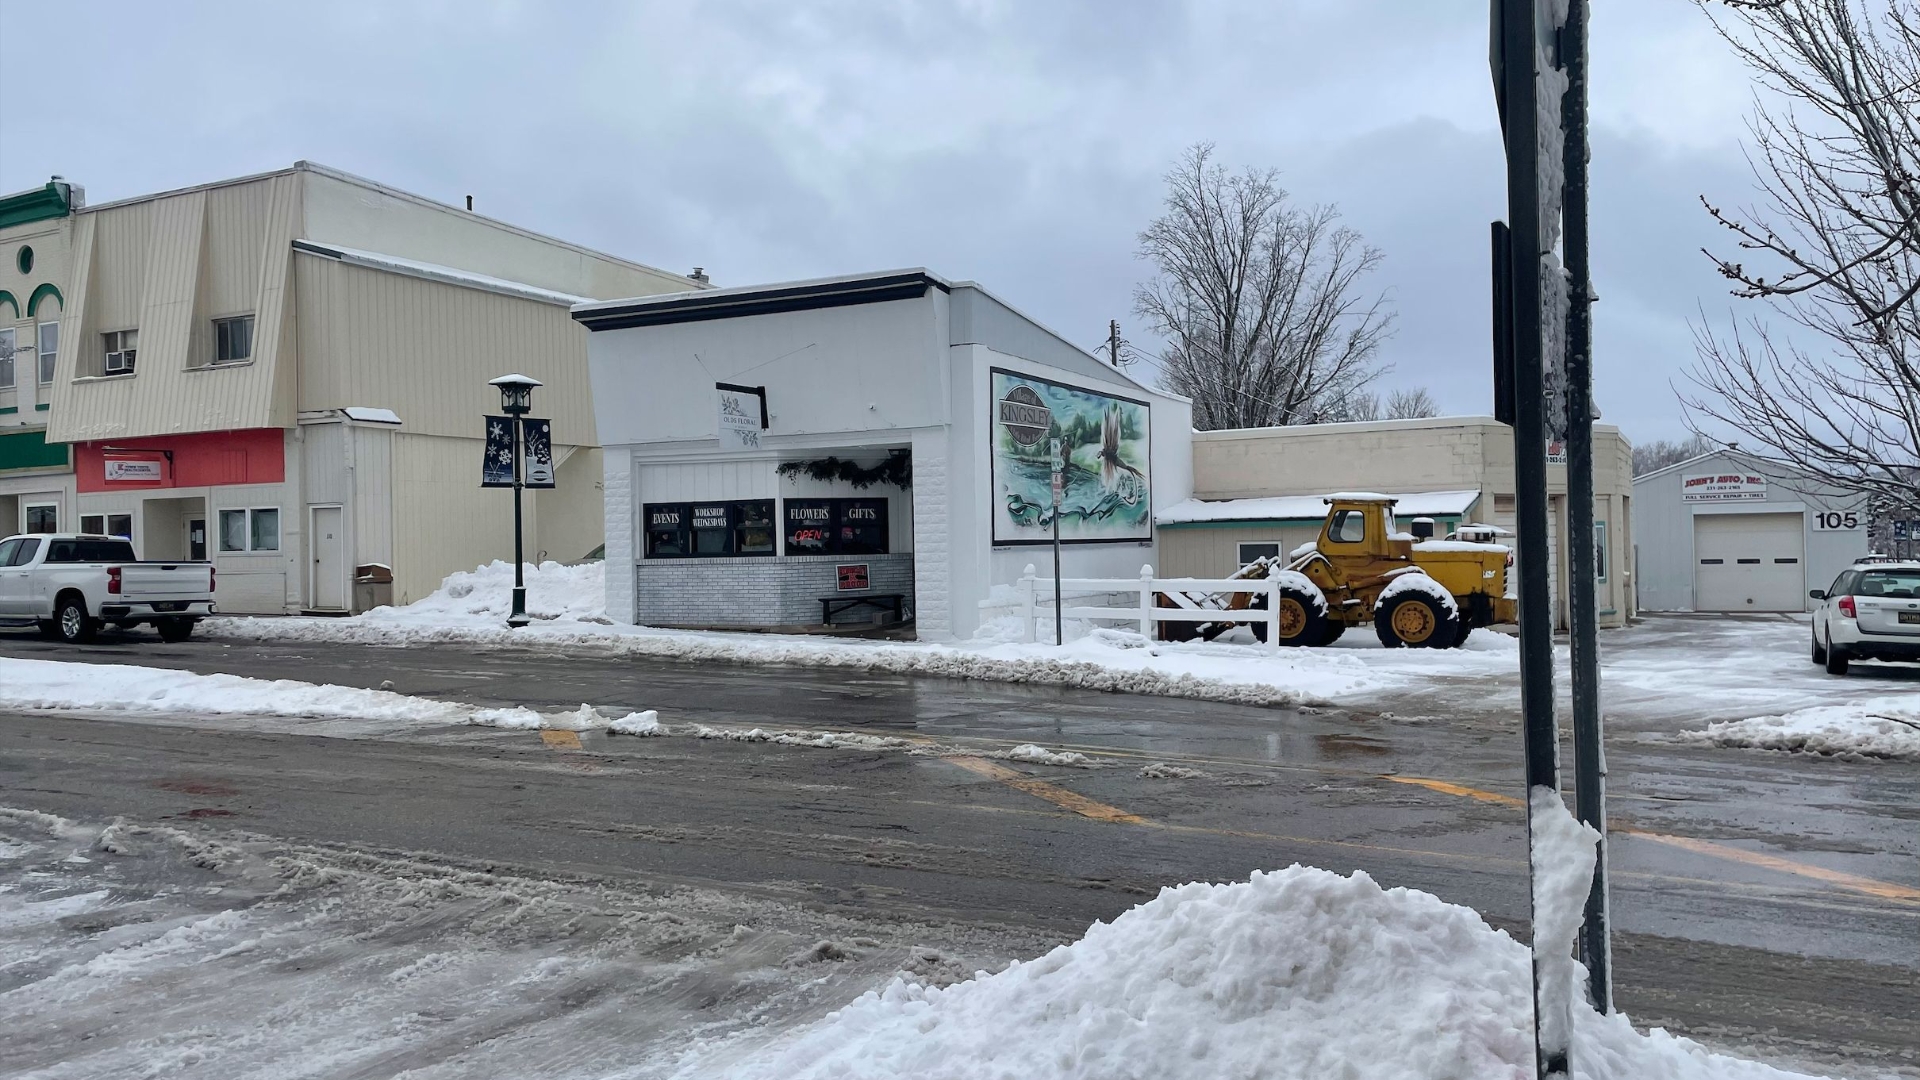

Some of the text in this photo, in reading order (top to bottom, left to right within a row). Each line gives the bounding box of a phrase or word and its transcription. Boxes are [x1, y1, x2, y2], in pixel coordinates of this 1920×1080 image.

[1000, 403, 1050, 426] KINGSLEY
[1684, 476, 1715, 488] JOHN'S
[1716, 475, 1744, 484] AUTO,
[694, 507, 725, 517] WORKSHOP
[790, 508, 829, 519] FLOWERS
[848, 508, 875, 519] GIFTS
[653, 513, 679, 525] EVENTS
[692, 517, 727, 527] WEDNESDAYS
[1815, 512, 1858, 529] 105
[794, 529, 822, 541] OPEN
